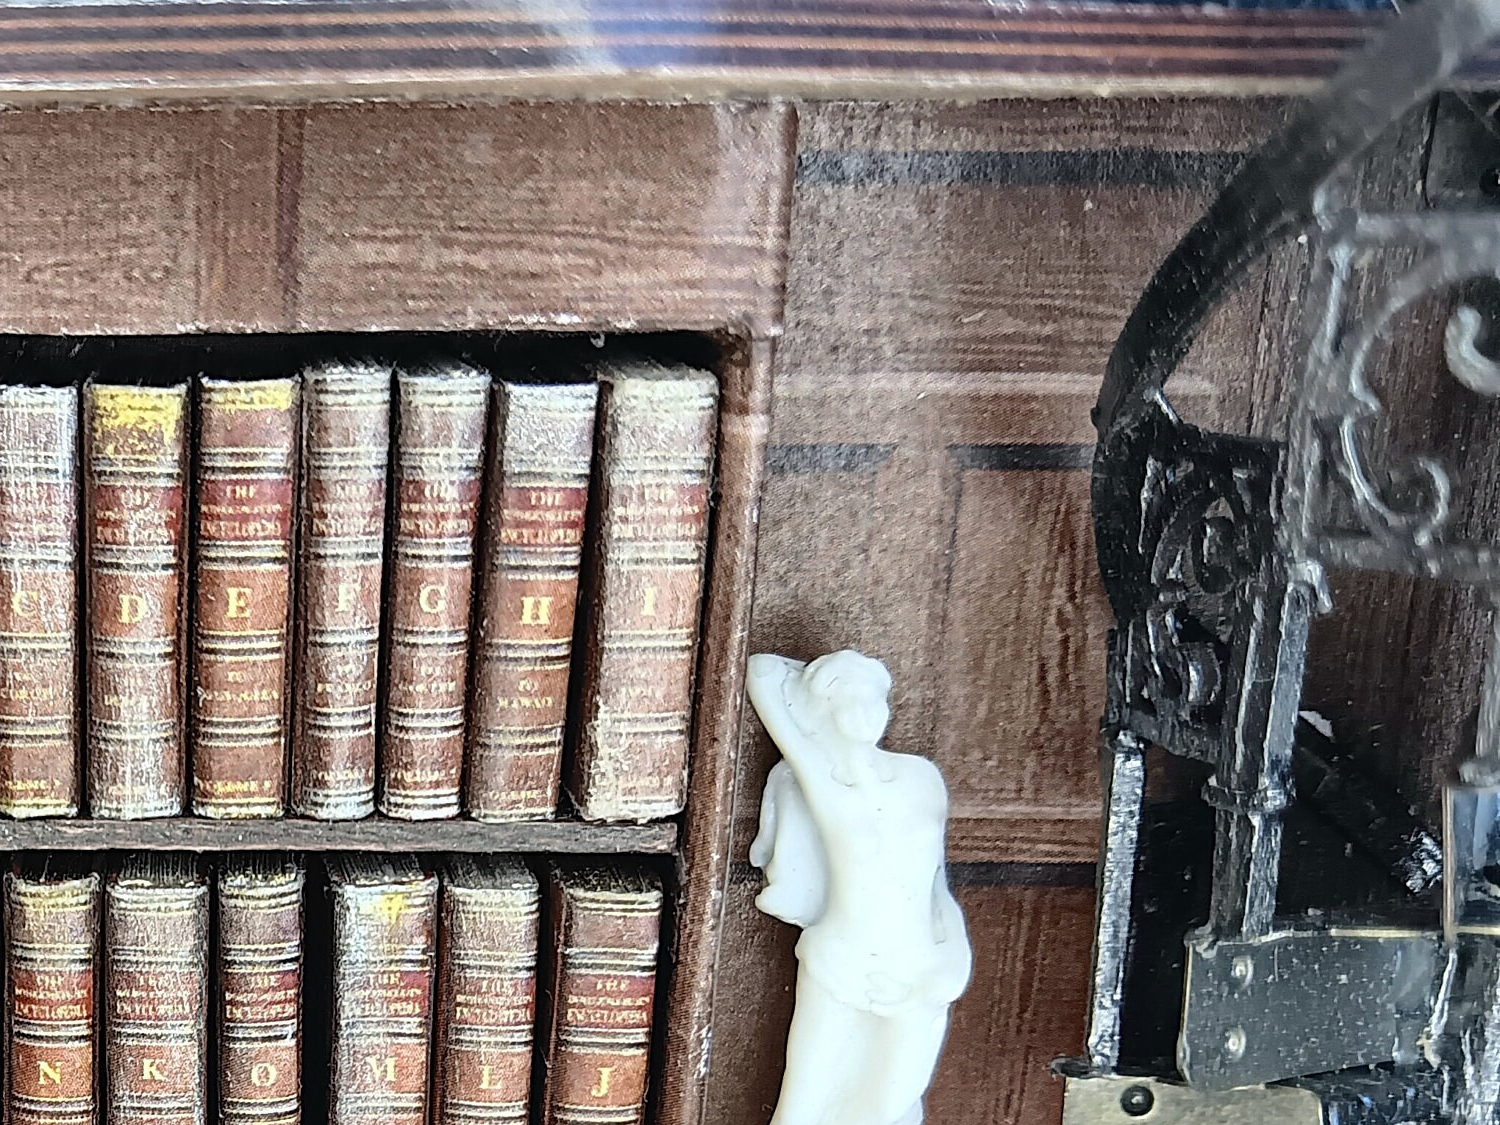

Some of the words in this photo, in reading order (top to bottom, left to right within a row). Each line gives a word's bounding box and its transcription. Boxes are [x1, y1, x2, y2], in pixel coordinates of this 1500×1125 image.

[12, 591, 38, 618] C
[119, 594, 145, 623] D
[227, 587, 252, 618] E
[338, 583, 361, 611] F
[419, 583, 446, 613] G
[521, 597, 552, 625] H
[642, 587, 657, 616] I
[38, 1062, 65, 1085] N
[141, 1058, 167, 1081] K
[251, 1062, 278, 1087] O
[480, 1065, 502, 1090] L
[591, 1067, 612, 1097] J
